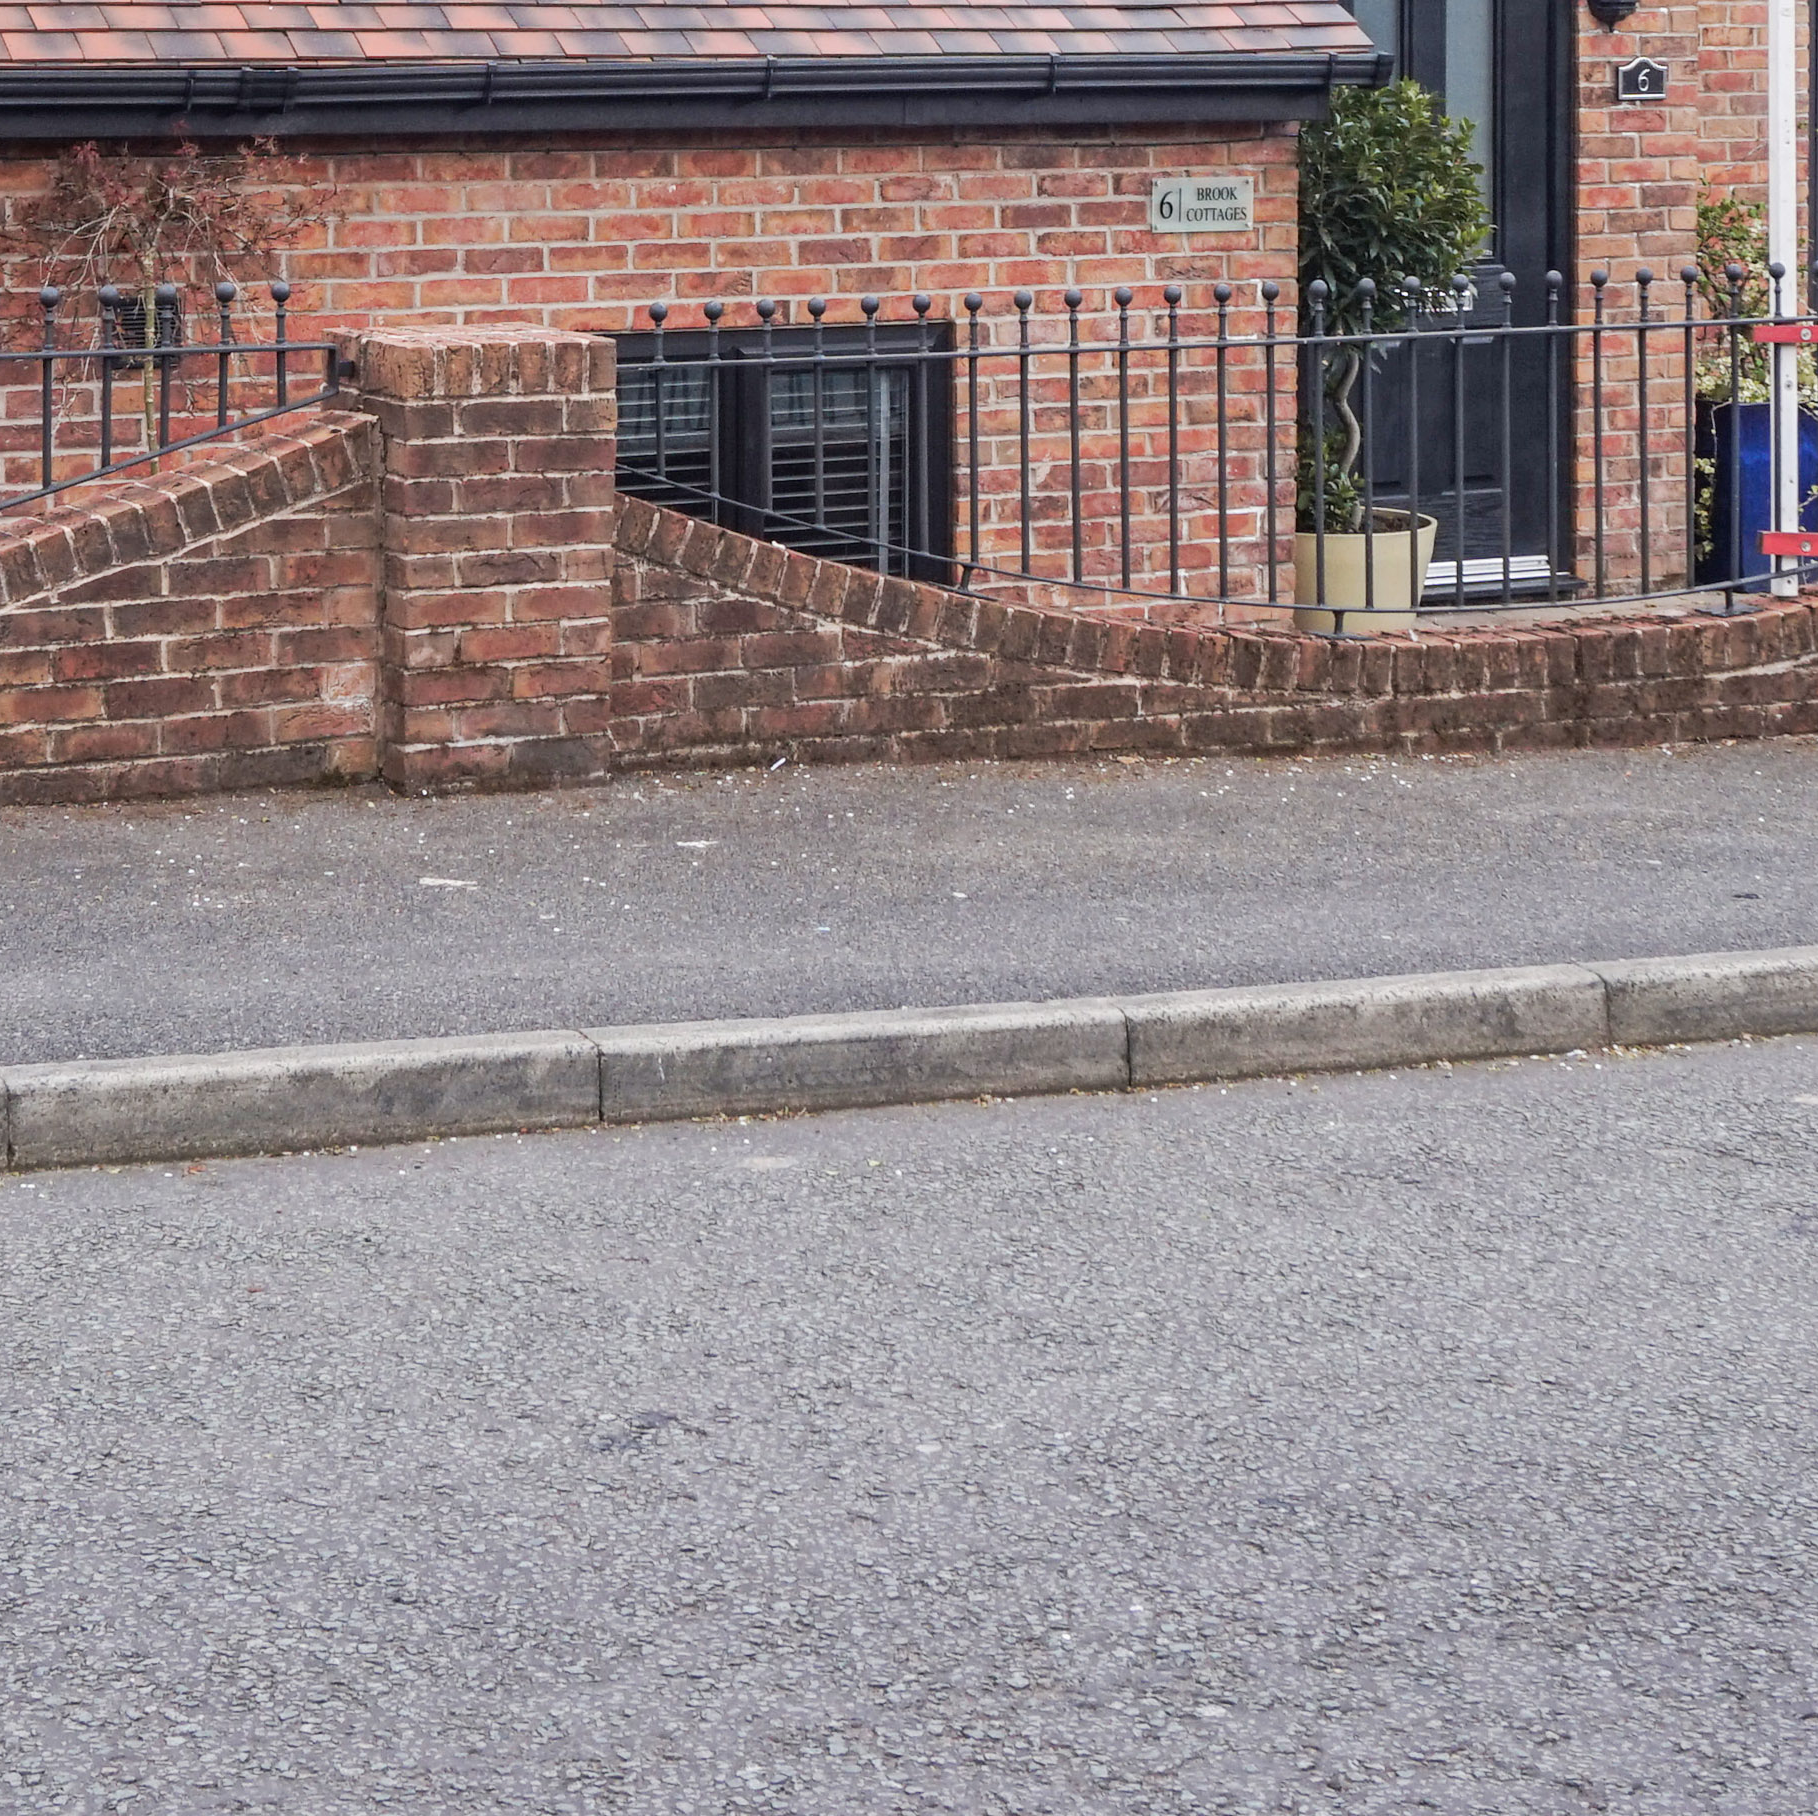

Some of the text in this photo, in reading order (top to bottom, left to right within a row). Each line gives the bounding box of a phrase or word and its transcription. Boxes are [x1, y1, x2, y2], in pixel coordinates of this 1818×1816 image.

[1638, 68, 1650, 92] 6
[1196, 186, 1238, 202] BROOK
[1159, 190, 1174, 220] 6
[1186, 206, 1247, 222] COTTAGES
